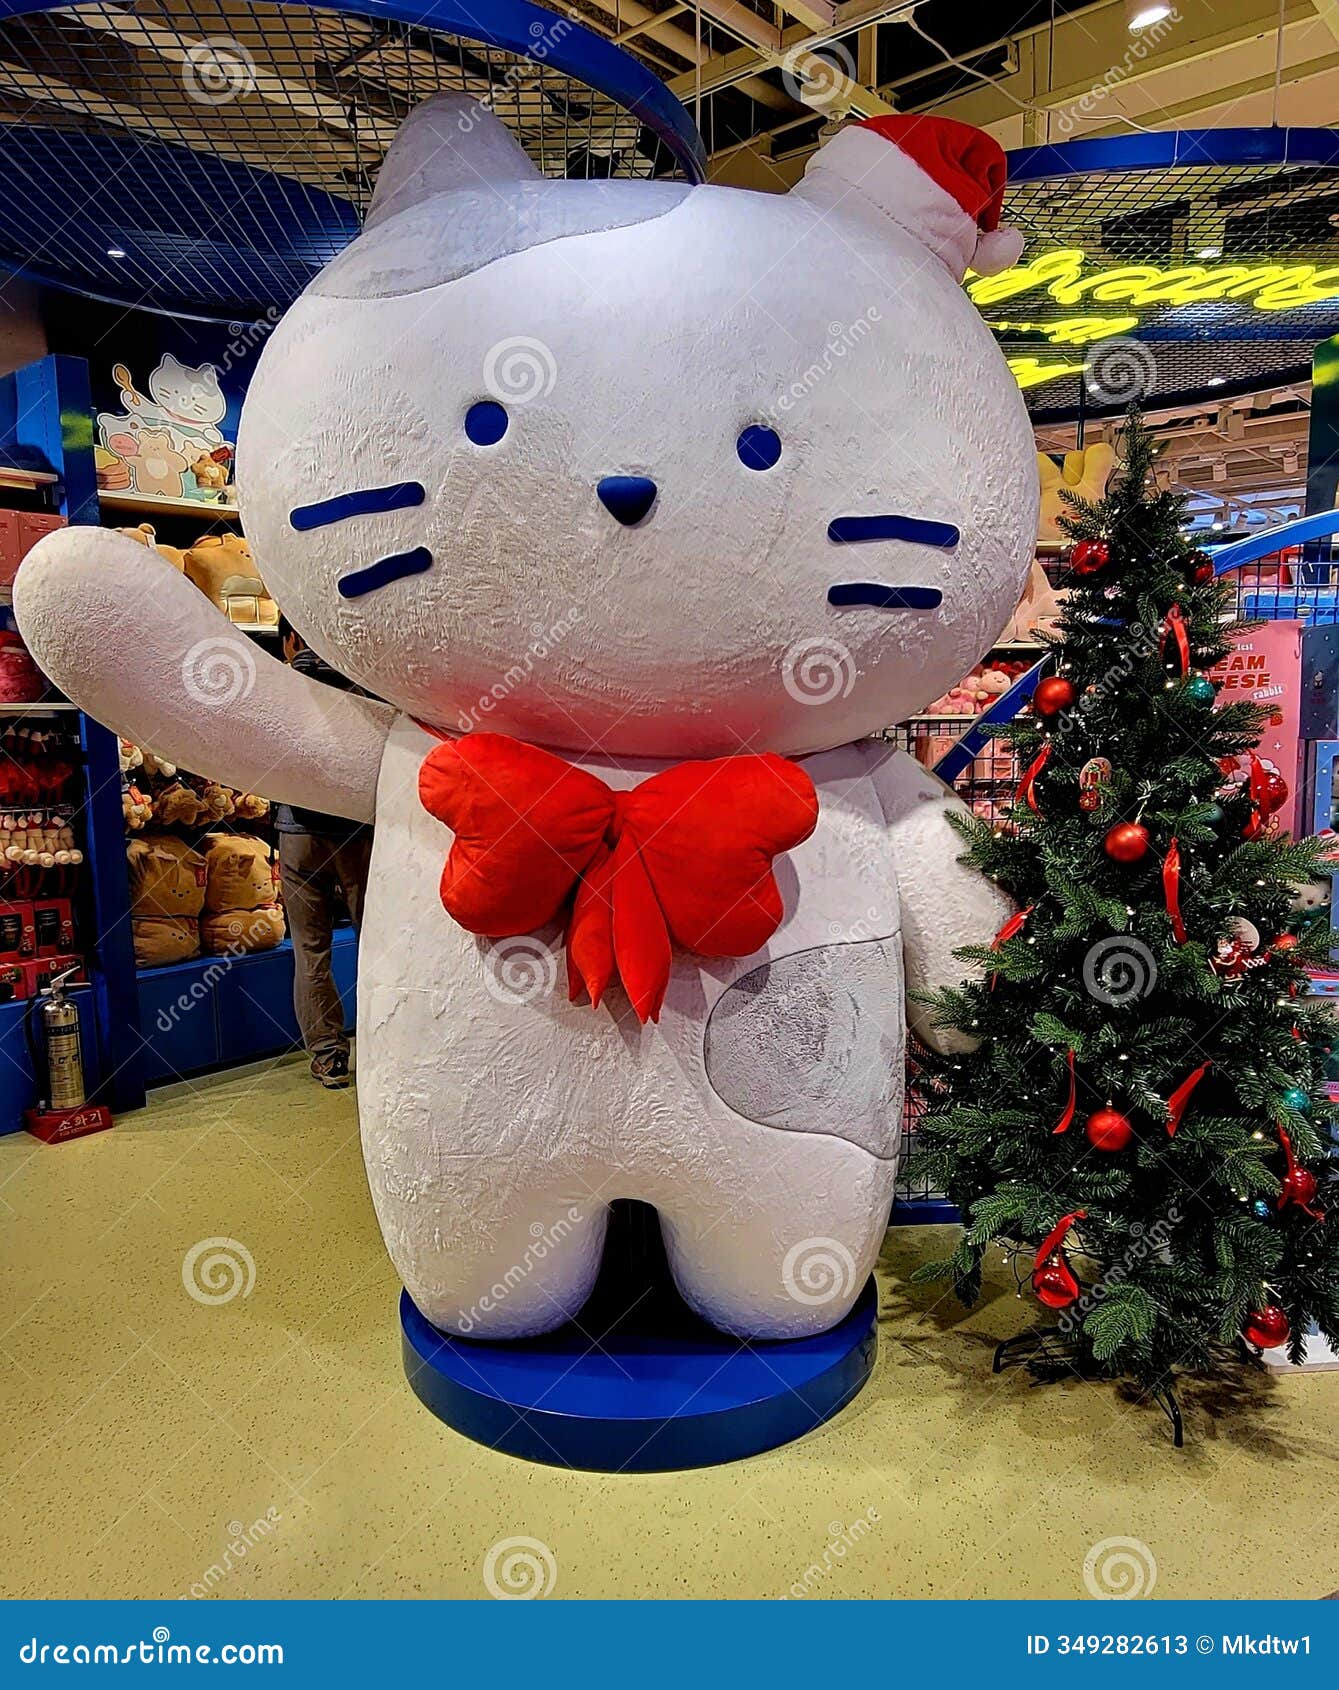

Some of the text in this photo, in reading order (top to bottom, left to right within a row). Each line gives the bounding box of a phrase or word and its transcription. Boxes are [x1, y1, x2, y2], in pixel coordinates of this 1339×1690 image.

[1214, 655, 1265, 671] EAM
[1253, 685, 1283, 699] rabbit
[59, 1110, 103, 1131] 소화기
